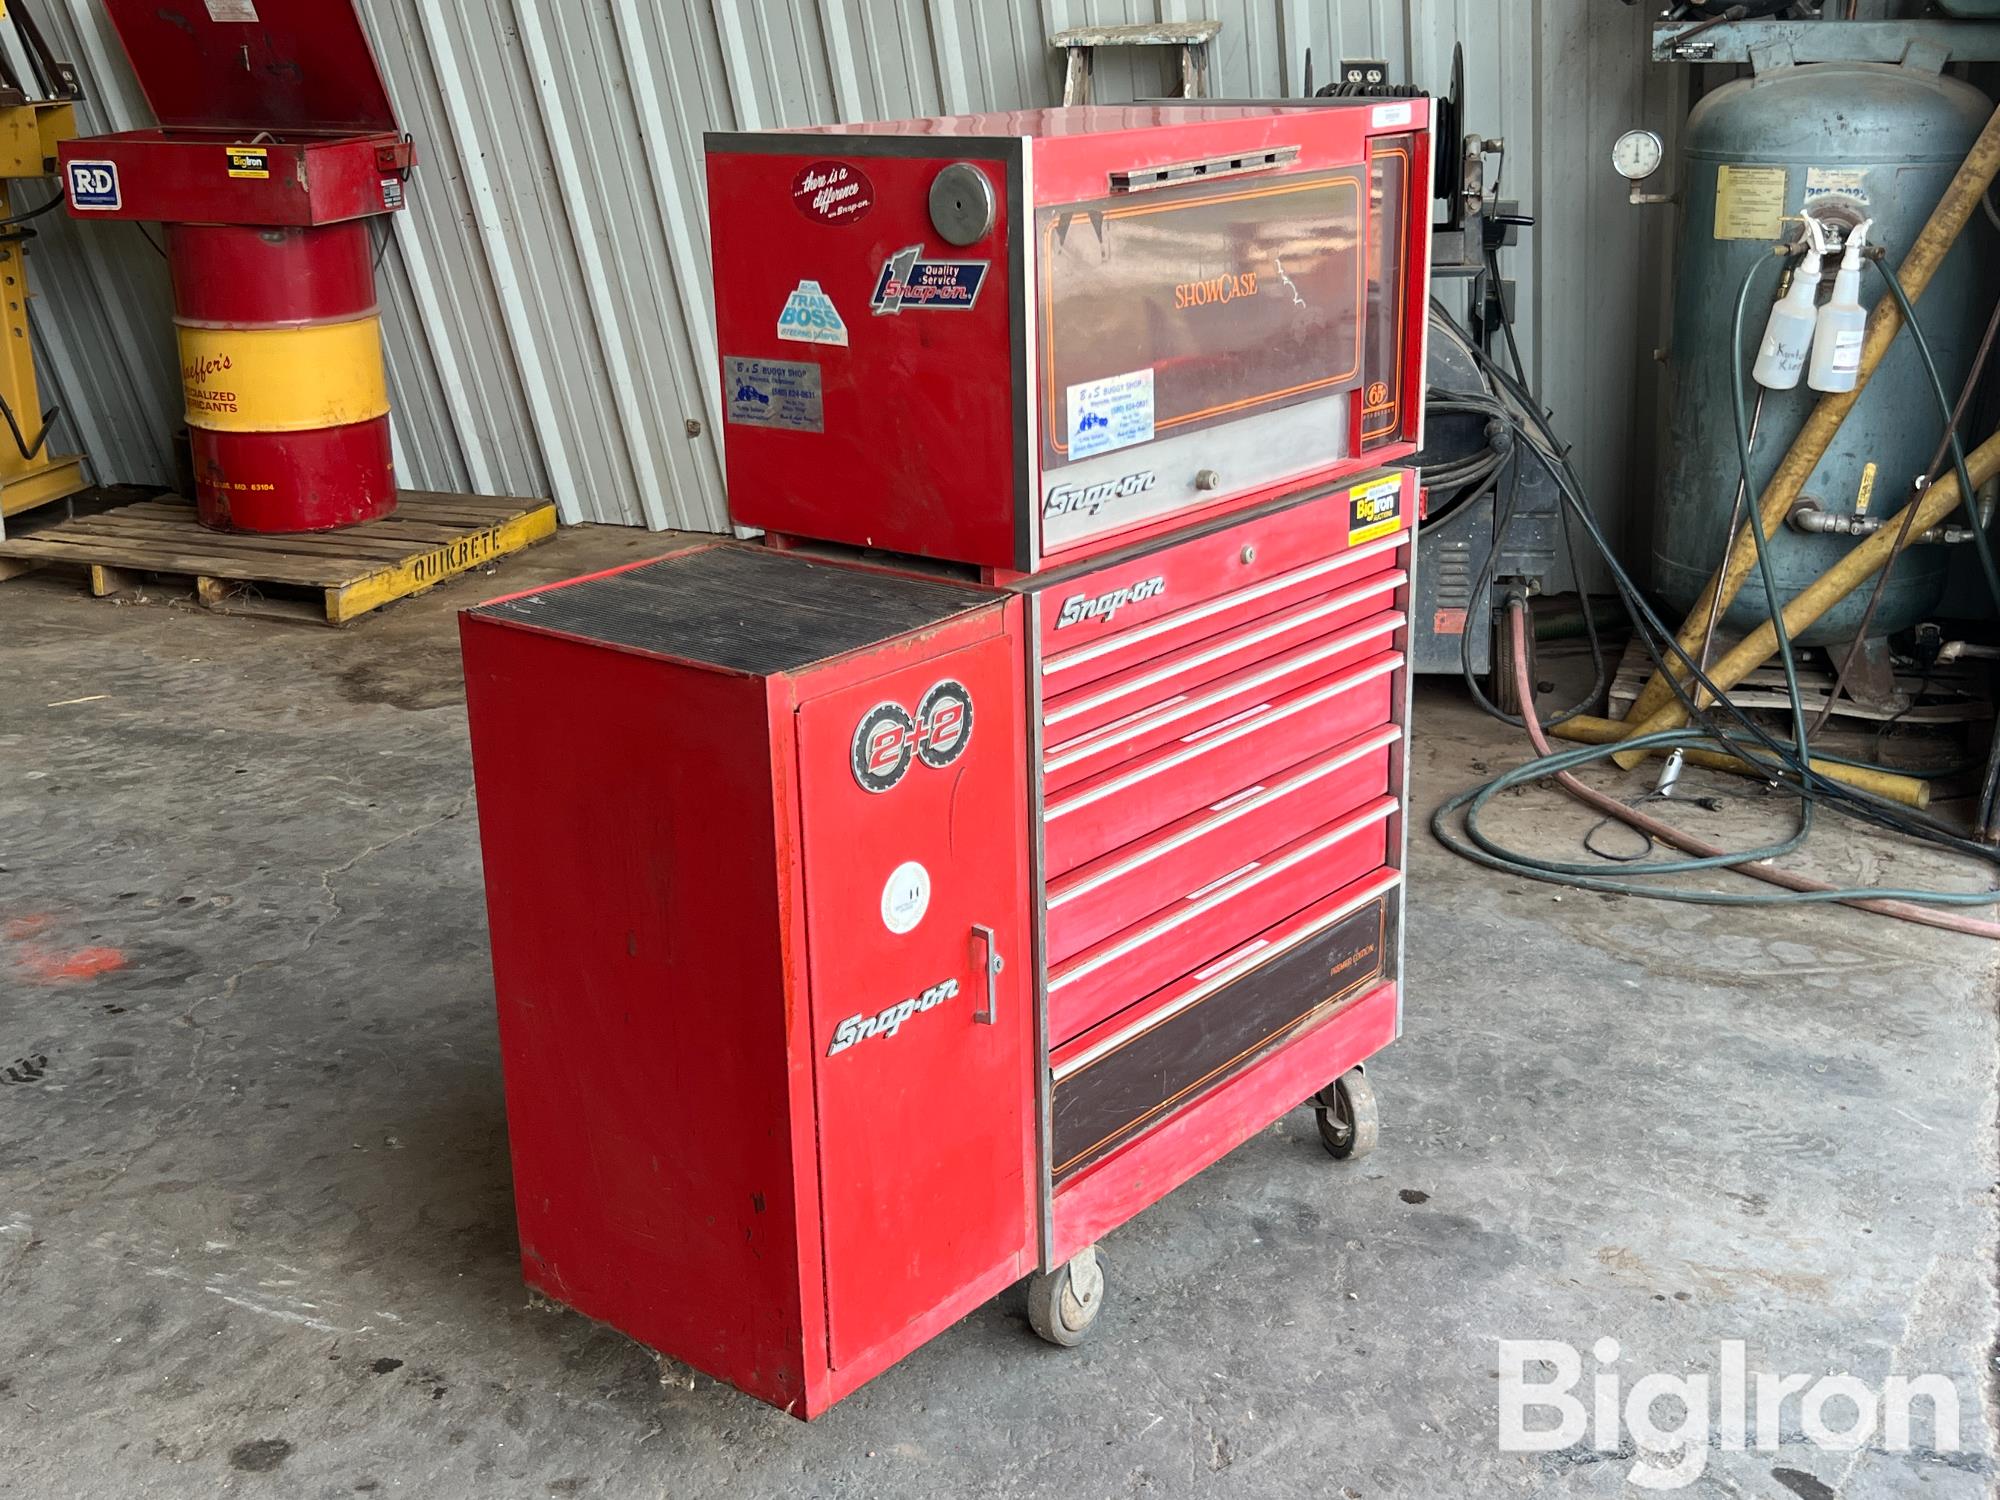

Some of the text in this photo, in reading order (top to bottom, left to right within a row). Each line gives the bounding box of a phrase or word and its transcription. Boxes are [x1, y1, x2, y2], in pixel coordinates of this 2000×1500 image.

[827, 168, 838, 186] is
[839, 168, 849, 181] a
[812, 183, 860, 214] difference
[921, 275, 957, 286] Service
[925, 265, 960, 277] Quality
[779, 306, 842, 330] BOSS
[1043, 470, 1156, 520] Snap-on
[414, 528, 500, 582] QUIKRETE
[1054, 576, 1166, 631] Snap-on
[866, 701, 965, 775] 2+2
[825, 977, 960, 1058] Snap-on
